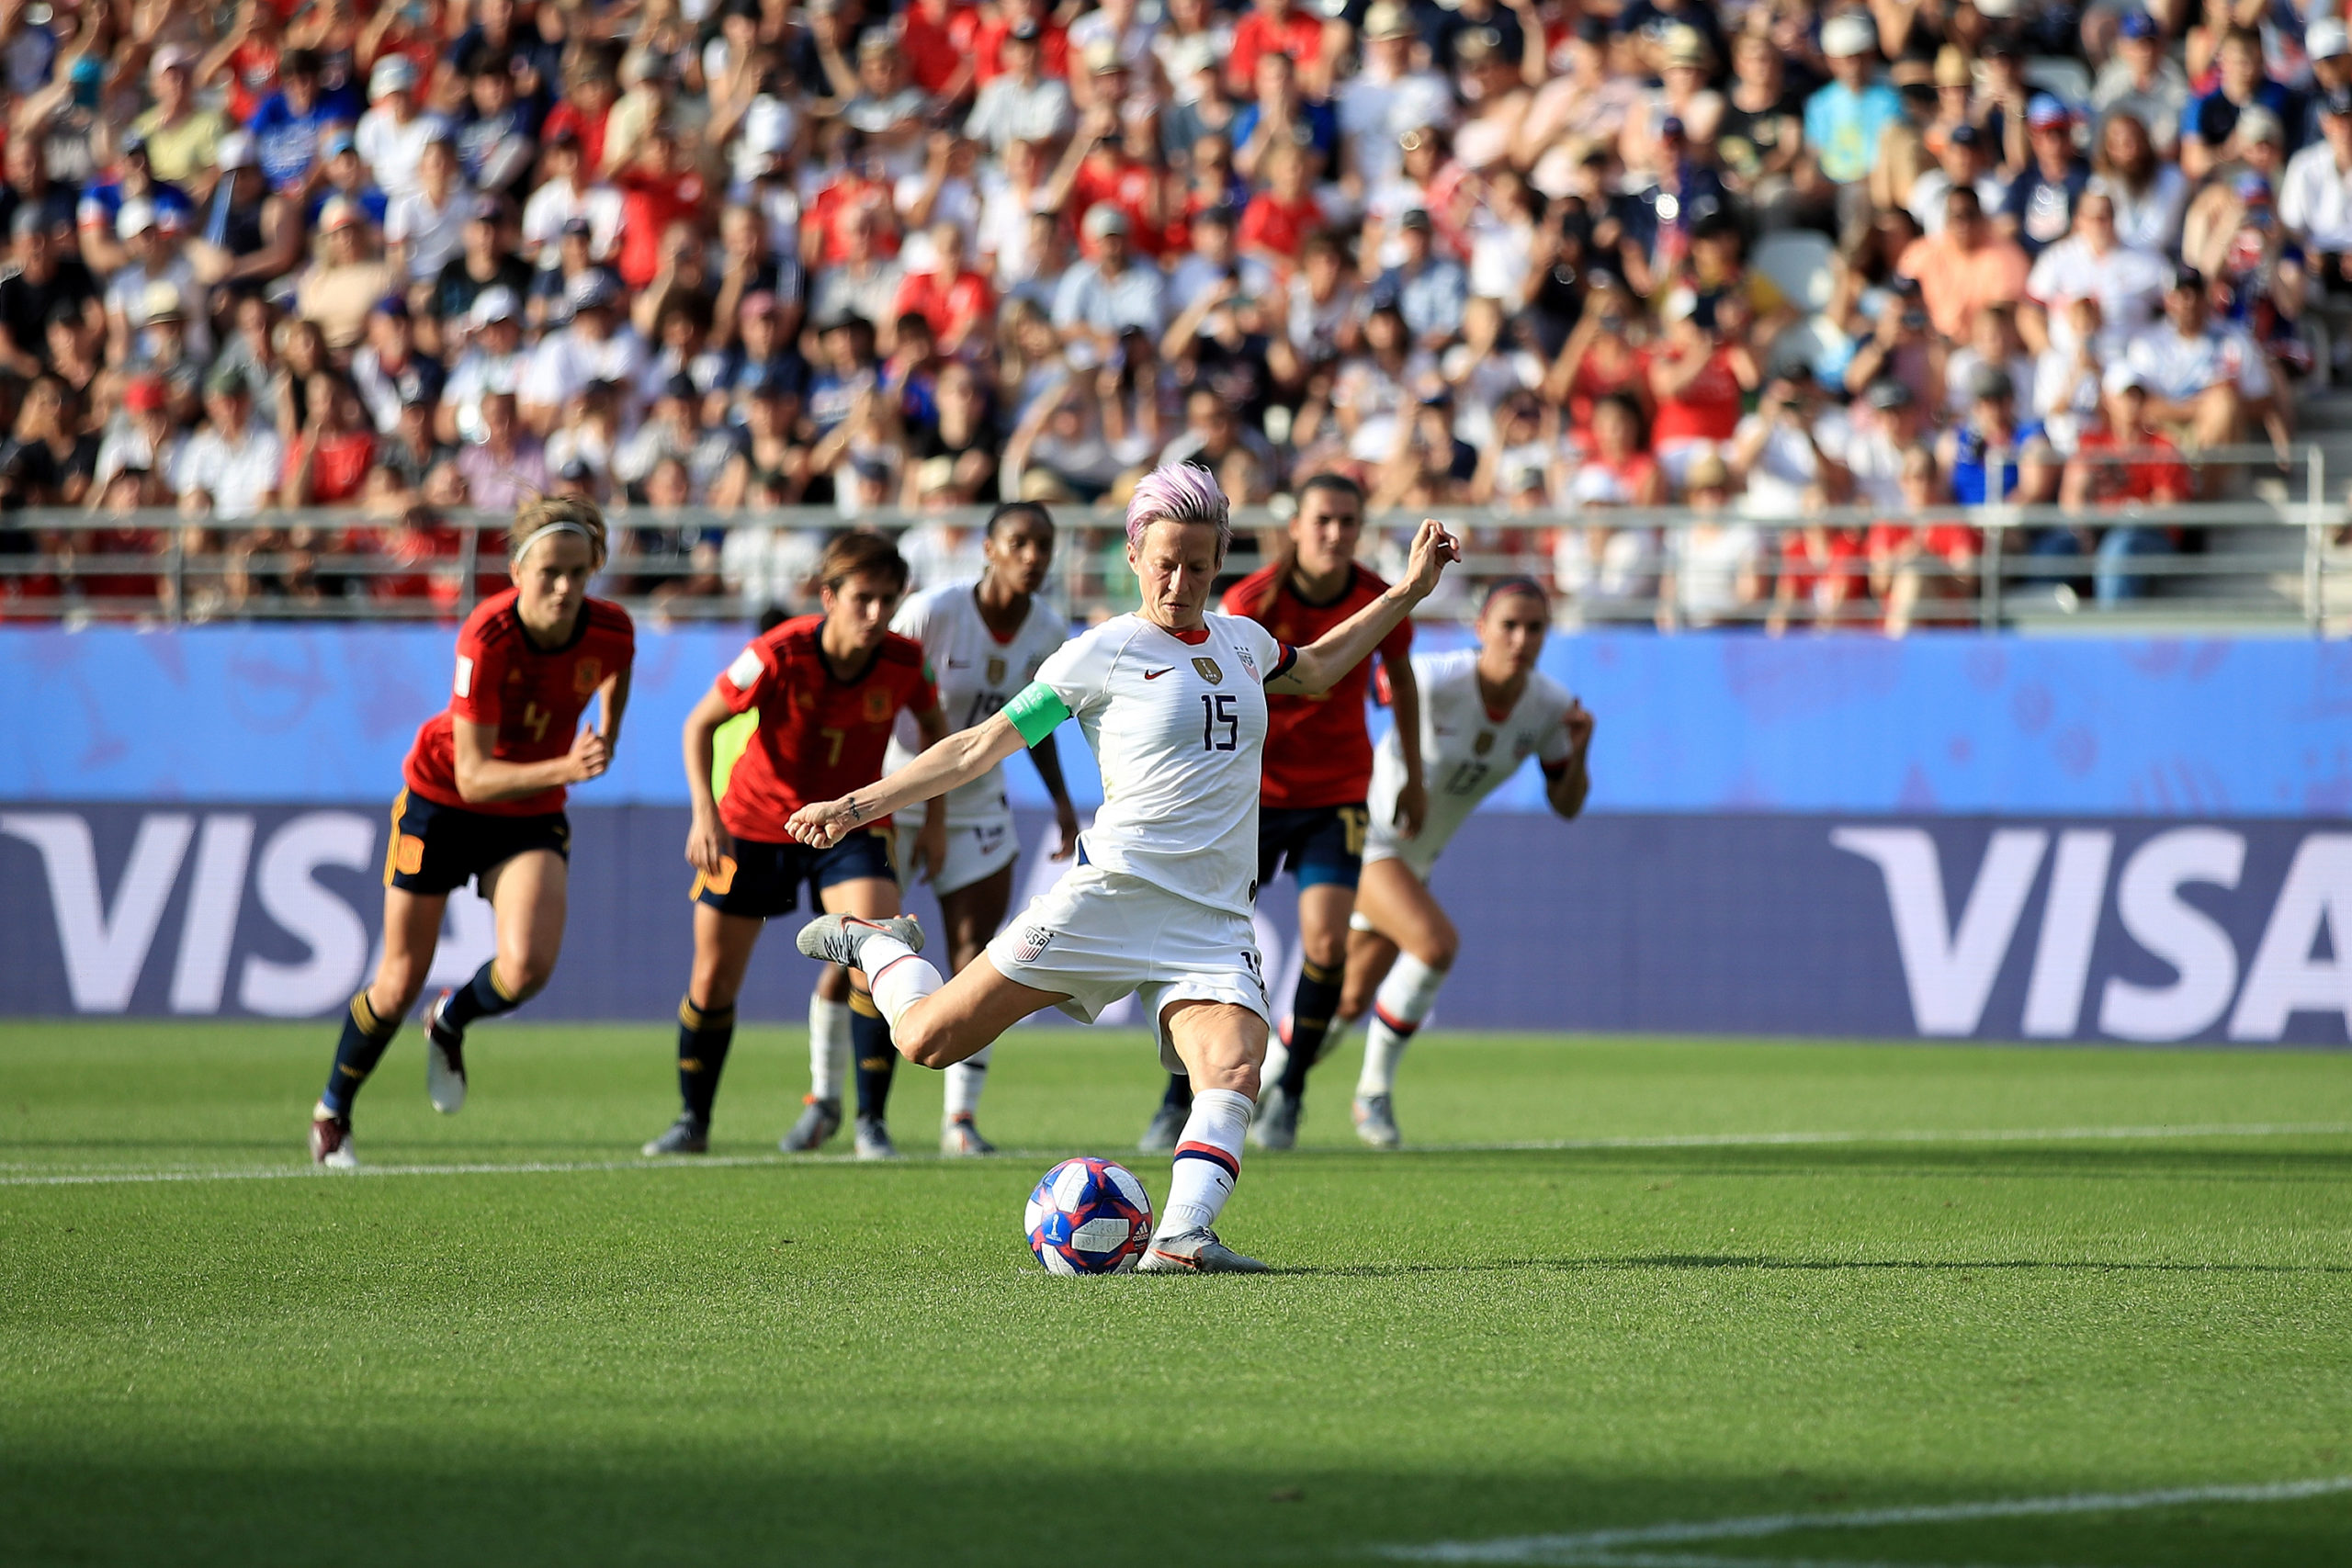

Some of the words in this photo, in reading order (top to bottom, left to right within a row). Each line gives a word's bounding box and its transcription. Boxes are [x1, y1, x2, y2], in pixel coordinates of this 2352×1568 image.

[524, 701, 550, 742] 4
[1202, 694, 1238, 751] 15
[820, 728, 845, 768] 7
[1025, 929, 1046, 947] USA
[1829, 827, 2352, 1043] VISA
